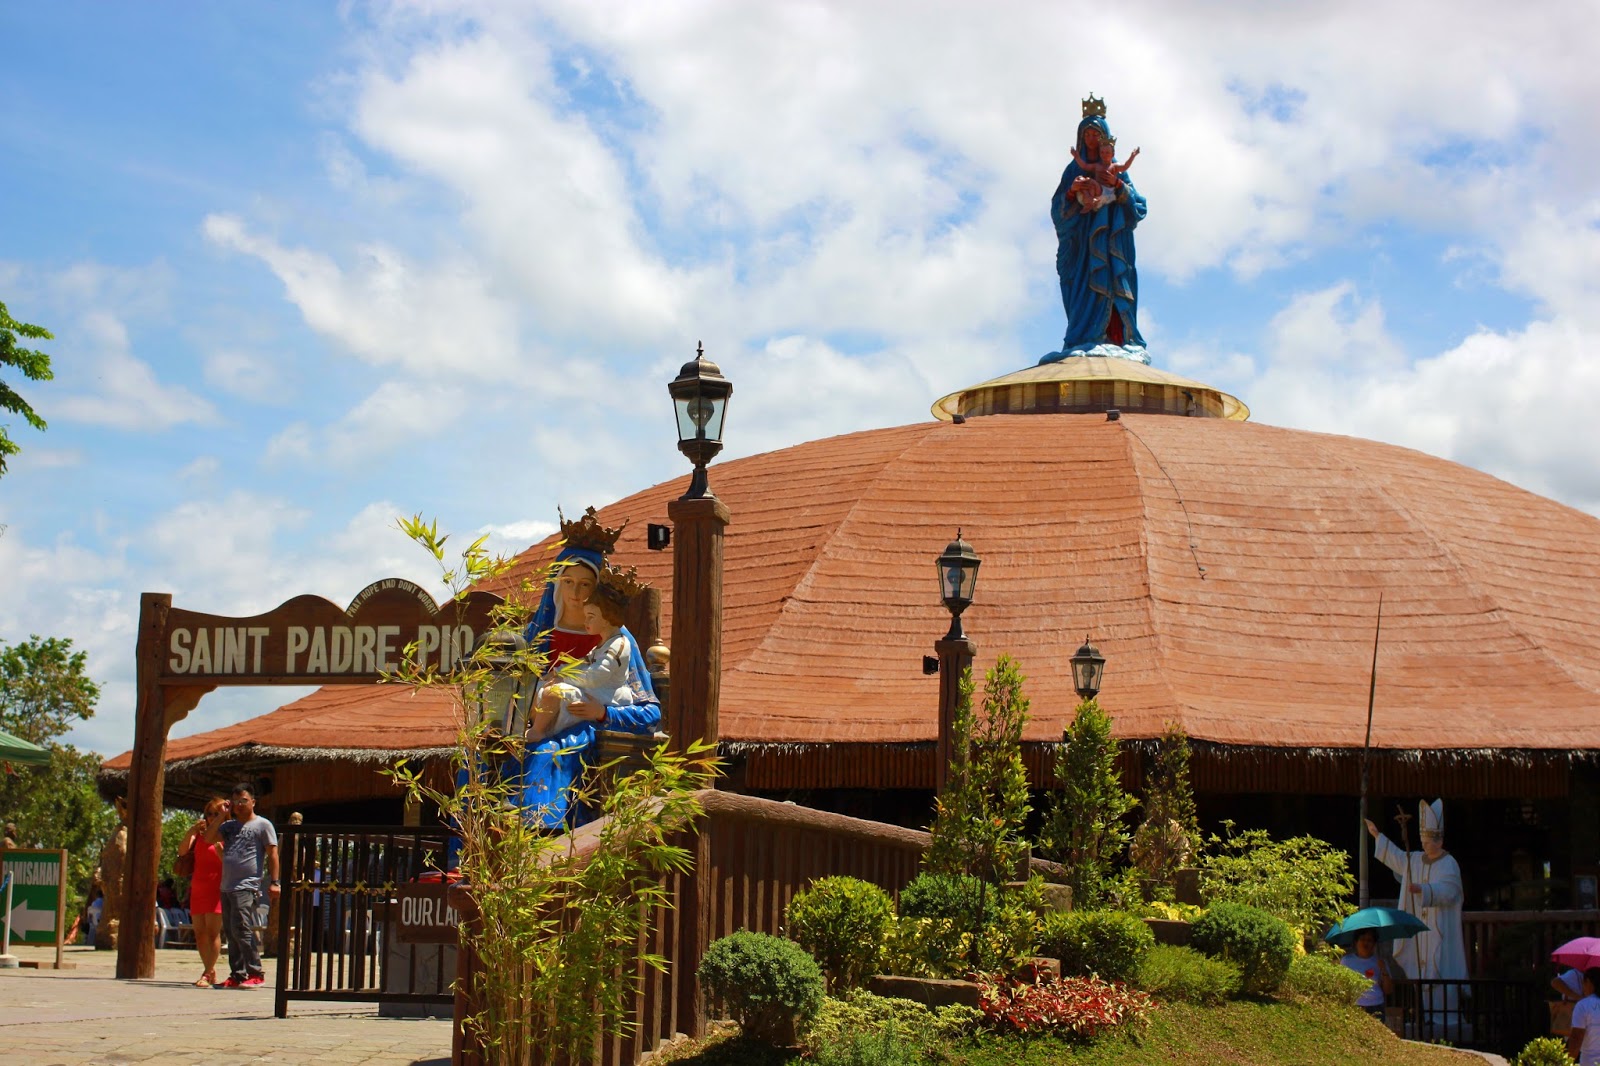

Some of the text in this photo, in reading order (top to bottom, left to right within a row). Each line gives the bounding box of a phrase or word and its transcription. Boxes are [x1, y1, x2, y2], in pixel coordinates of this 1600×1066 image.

[381, 579, 396, 590] AND
[417, 590, 439, 616] WORRY!
[169, 624, 474, 674] SAINT PADRE PIO
[401, 896, 434, 926] OUR
